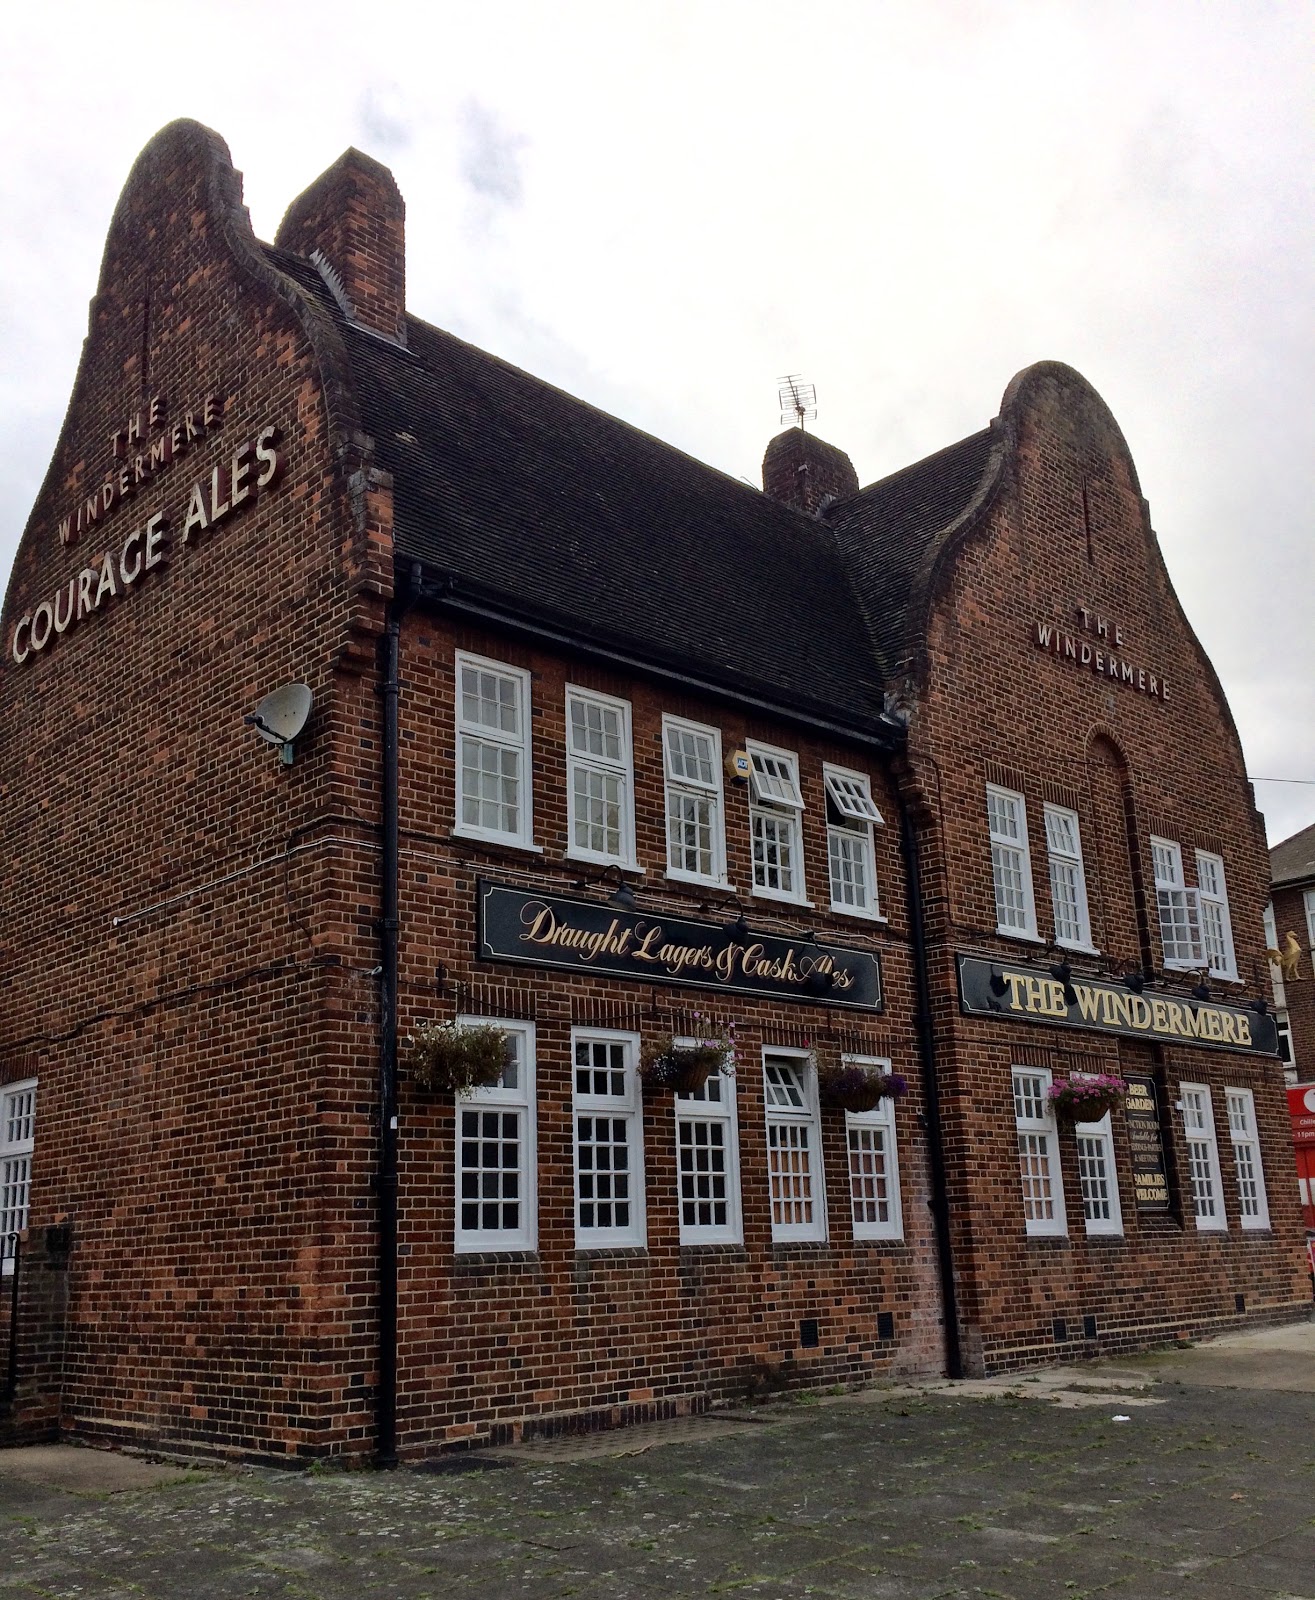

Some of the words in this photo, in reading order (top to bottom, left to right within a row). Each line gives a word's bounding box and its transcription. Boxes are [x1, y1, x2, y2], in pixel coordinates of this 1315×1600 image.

[111, 395, 166, 458] THE
[58, 393, 223, 546] WINDERMERE
[12, 511, 169, 664] COURAGE
[182, 425, 280, 545] ALES
[1036, 622, 1171, 700] WINDERMERE
[1079, 607, 1124, 646] THE
[519, 900, 633, 961] Draught
[632, 920, 712, 974] Lagers
[715, 941, 744, 981] &
[742, 943, 797, 981] Cask
[1002, 971, 1069, 1017] THE
[1070, 984, 1253, 1046] WINDERMERE
[1126, 1098, 1155, 1110] GARDEN
[1129, 1084, 1148, 1096] BEER
